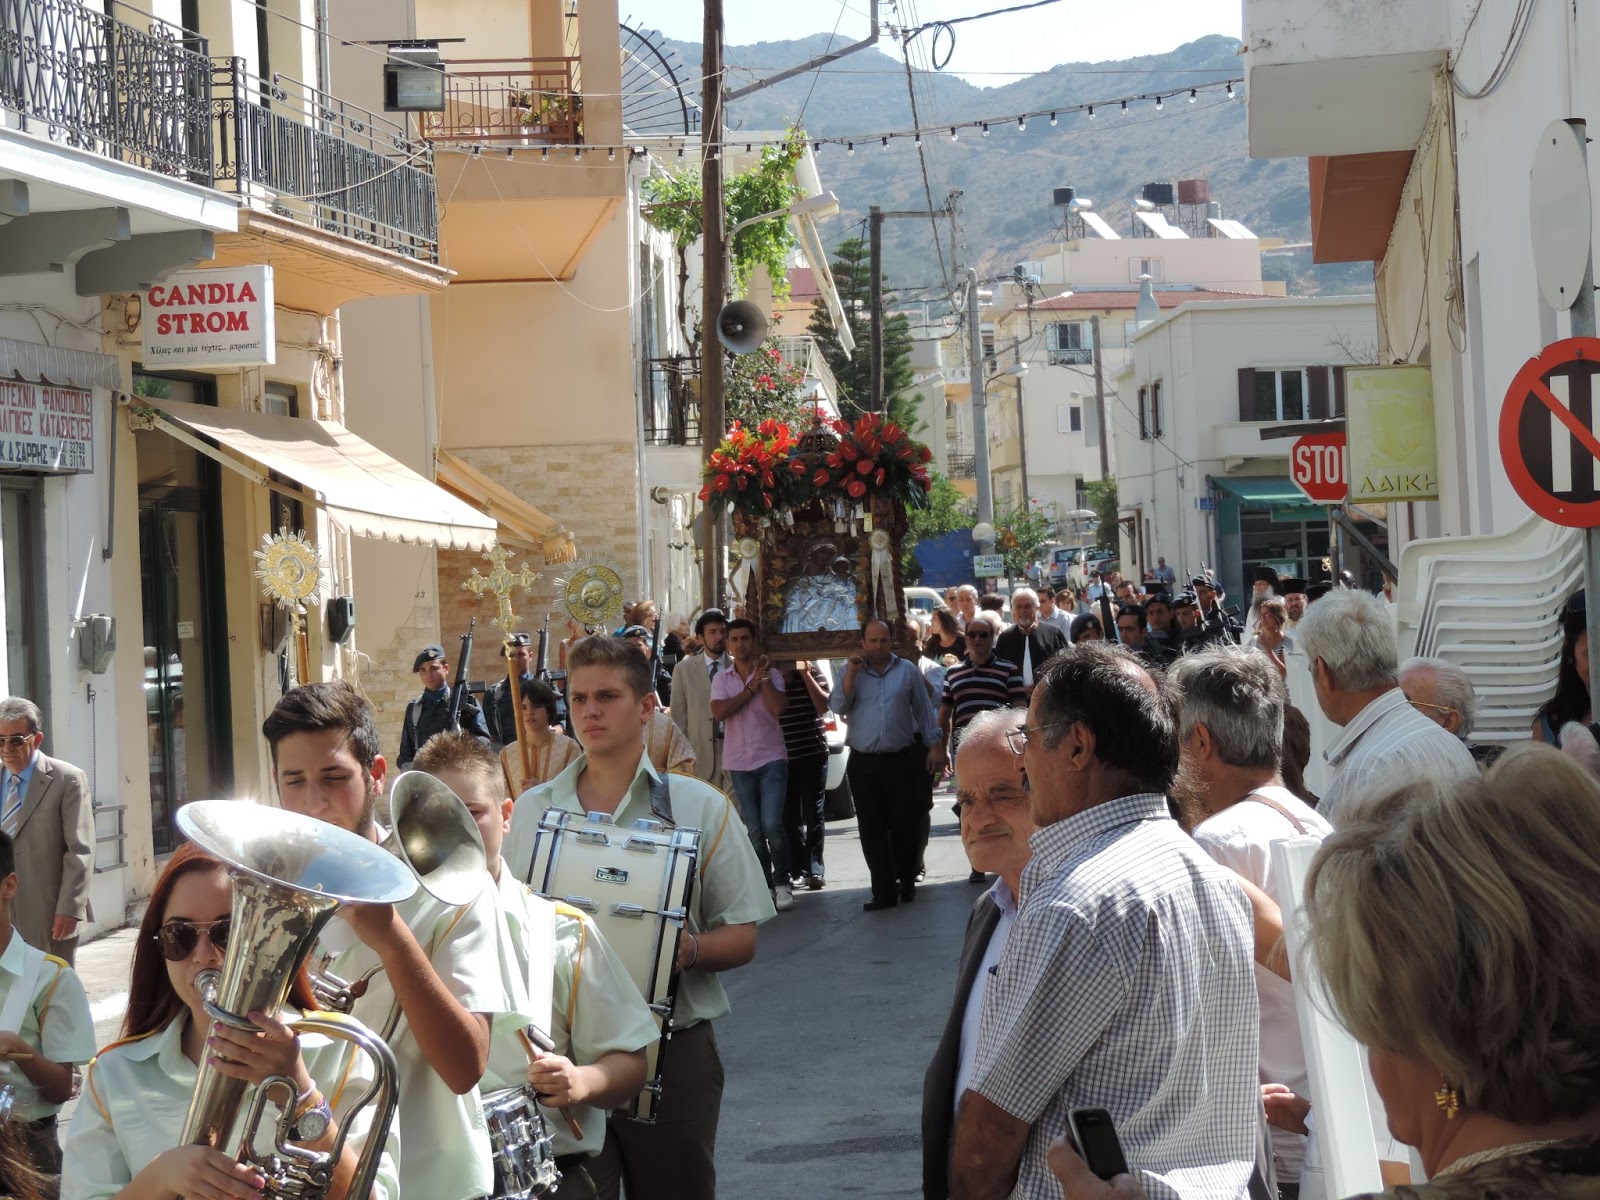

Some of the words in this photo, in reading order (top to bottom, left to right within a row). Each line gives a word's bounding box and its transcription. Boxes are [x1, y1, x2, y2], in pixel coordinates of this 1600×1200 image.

[148, 282, 257, 307] CANDIA
[157, 311, 249, 335] STROM
[1296, 445, 1347, 484] STO
